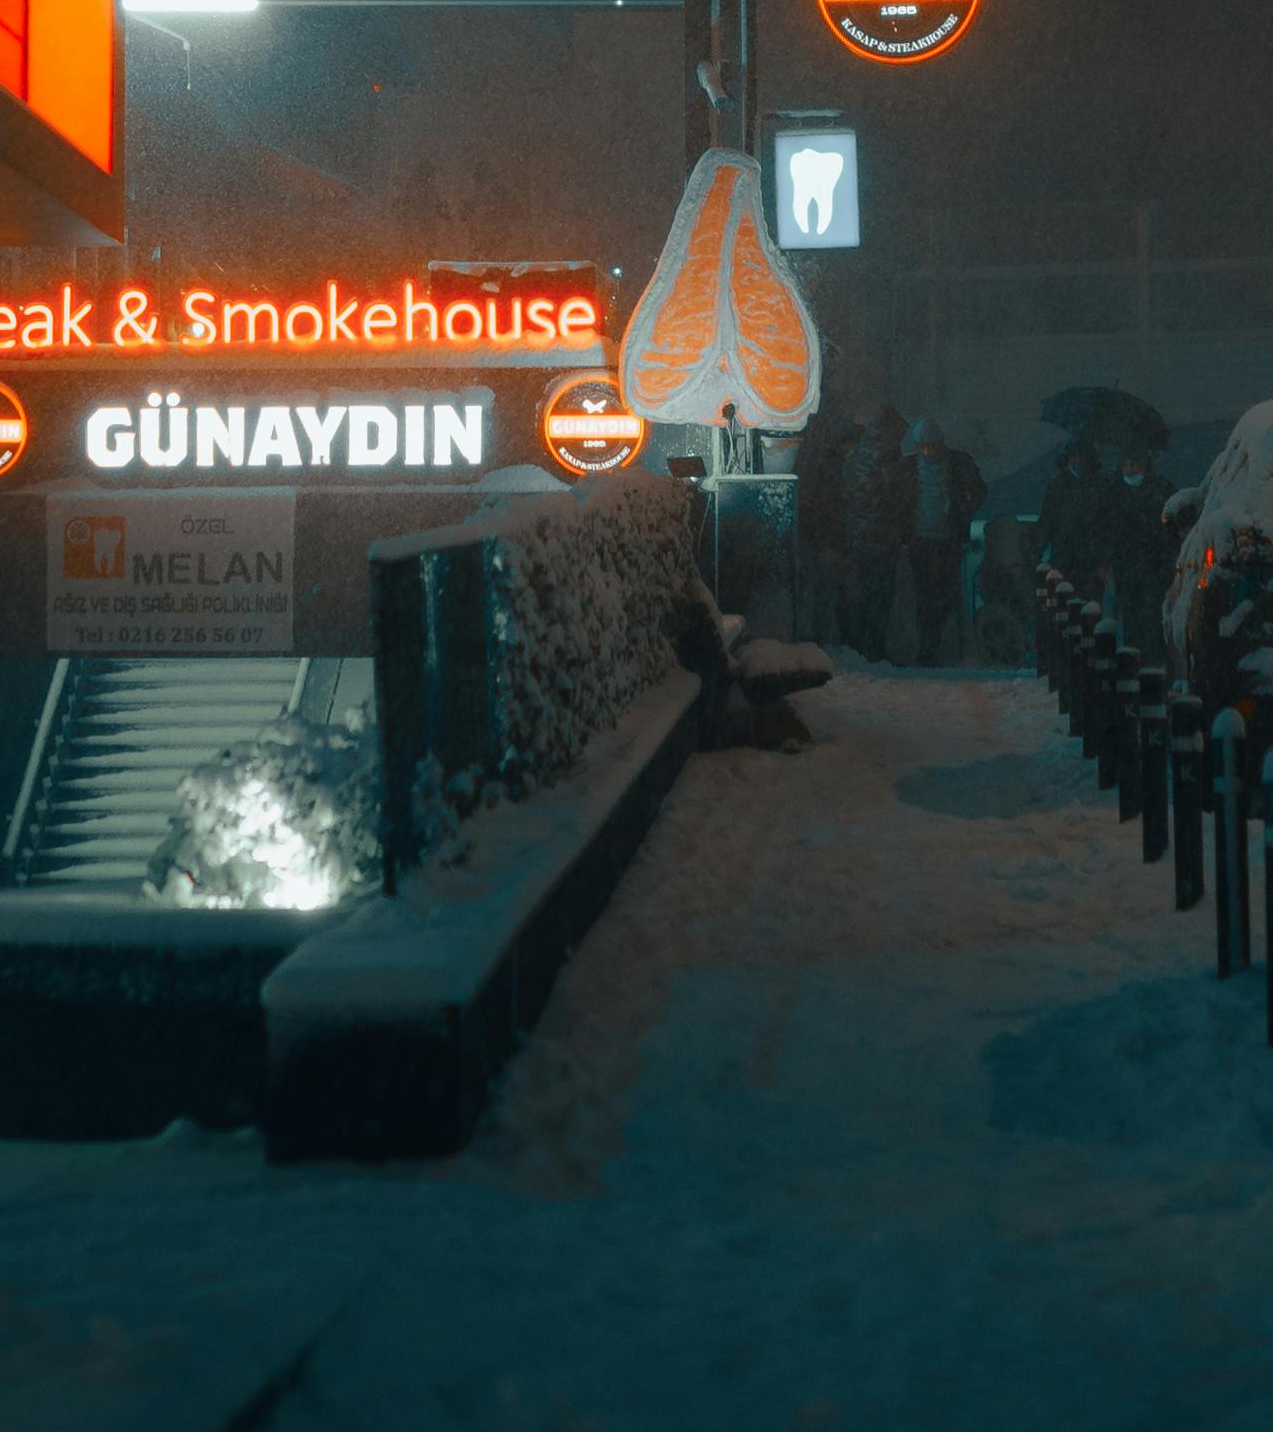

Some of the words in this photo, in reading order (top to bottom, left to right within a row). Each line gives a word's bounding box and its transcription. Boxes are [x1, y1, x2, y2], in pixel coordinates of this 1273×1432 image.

[113, 290, 157, 349] &
[182, 279, 597, 349] Smokehouse
[85, 392, 485, 469] GÜNAYDIN
[180, 514, 235, 535] ÖZEL
[132, 550, 284, 586] MELAN
[90, 595, 109, 614] VE
[118, 627, 166, 645] 0216
